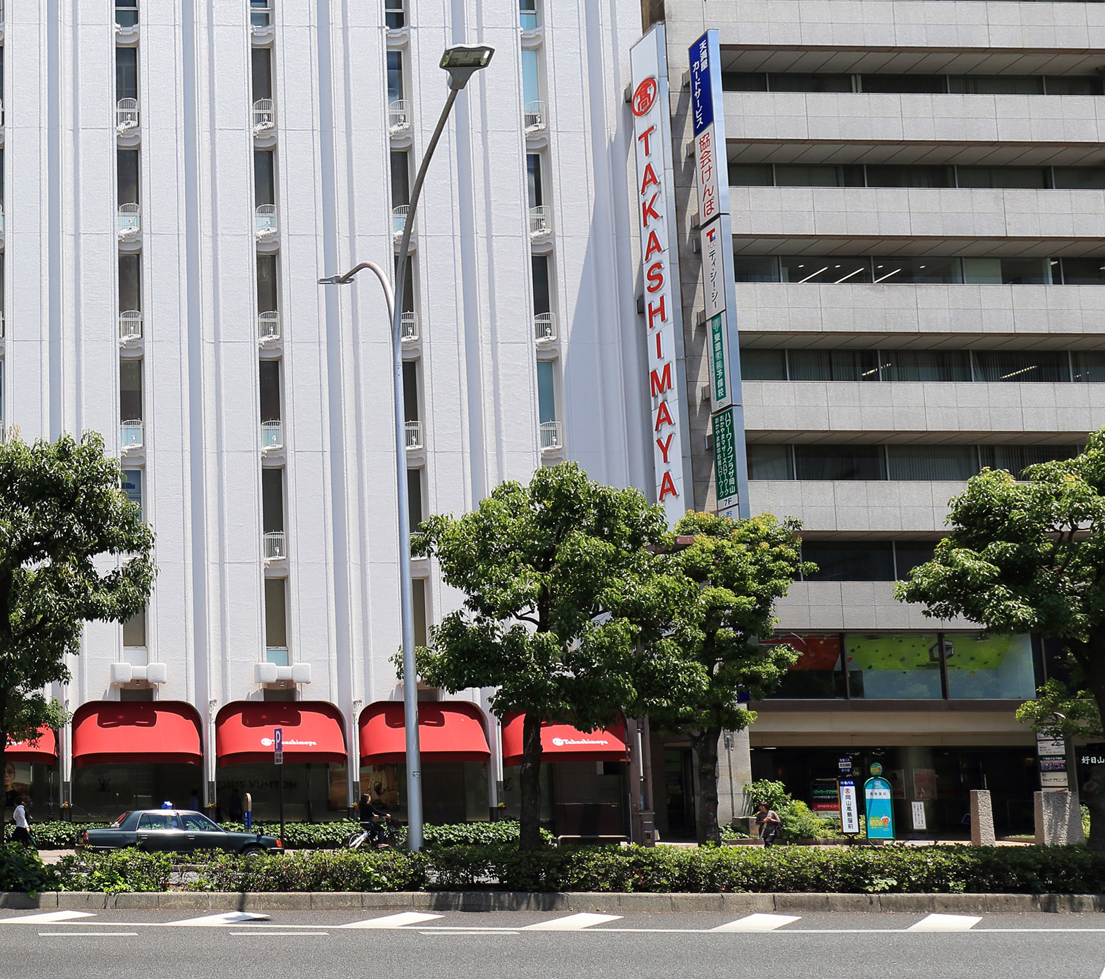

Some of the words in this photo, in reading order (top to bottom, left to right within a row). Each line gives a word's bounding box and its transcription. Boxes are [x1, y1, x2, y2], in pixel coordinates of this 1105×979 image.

[692, 61, 704, 130] カードサービス
[698, 132, 715, 218] 協会けんぽ
[638, 125, 677, 502] TAKASHIMAYA
[724, 412, 736, 494] ハローワークプラザ岡山
[723, 498, 733, 507] 7F
[275, 730, 282, 749] P
[563, 738, 609, 746] Takashimaya
